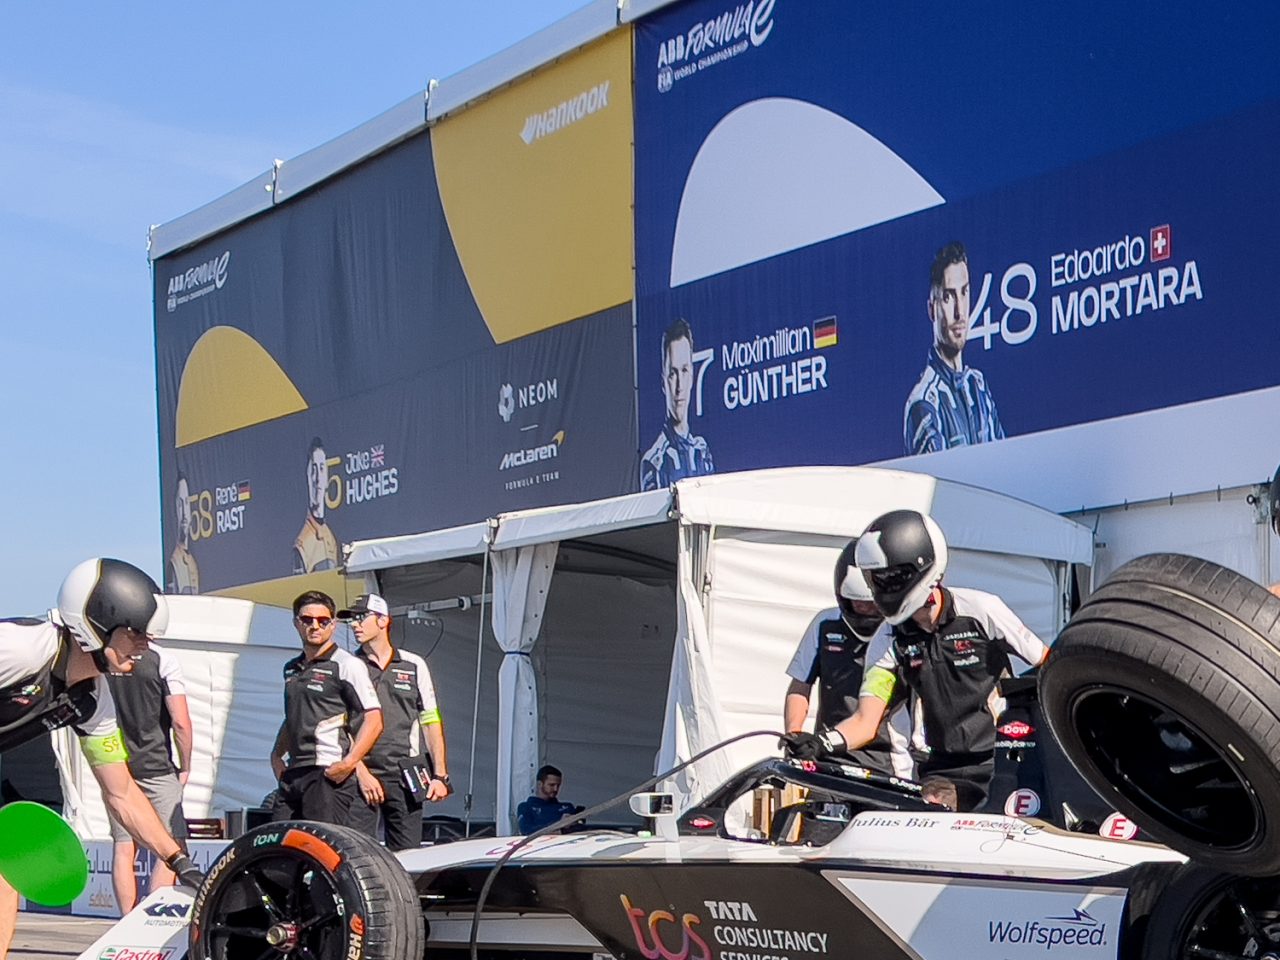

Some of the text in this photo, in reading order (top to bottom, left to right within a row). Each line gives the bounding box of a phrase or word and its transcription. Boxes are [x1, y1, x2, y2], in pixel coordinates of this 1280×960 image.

[657, 36, 685, 68] ABB
[685, 2, 752, 61] FORMULA
[674, 61, 697, 81] WORLD
[1050, 234, 1145, 287] Edoardo
[965, 262, 1037, 350] 48
[1051, 260, 1203, 334] MORTARA
[519, 378, 558, 408] NEOM
[691, 348, 714, 417] 7
[723, 355, 828, 410] GÜNTHER
[345, 451, 370, 474] Jake
[499, 443, 557, 470] McLaren
[215, 483, 238, 506] René
[345, 467, 399, 505] HUGHES
[505, 477, 534, 491] FORMULA
[542, 471, 560, 483] TEAM
[187, 490, 214, 542] 58
[216, 505, 246, 534] RAST
[1014, 795, 1031, 816] E
[905, 817, 941, 830] Bär
[1108, 818, 1128, 838] E
[144, 917, 192, 928] AUTOMOTIV
[704, 900, 758, 922] TATA
[714, 924, 827, 953] CONSULTANCY
